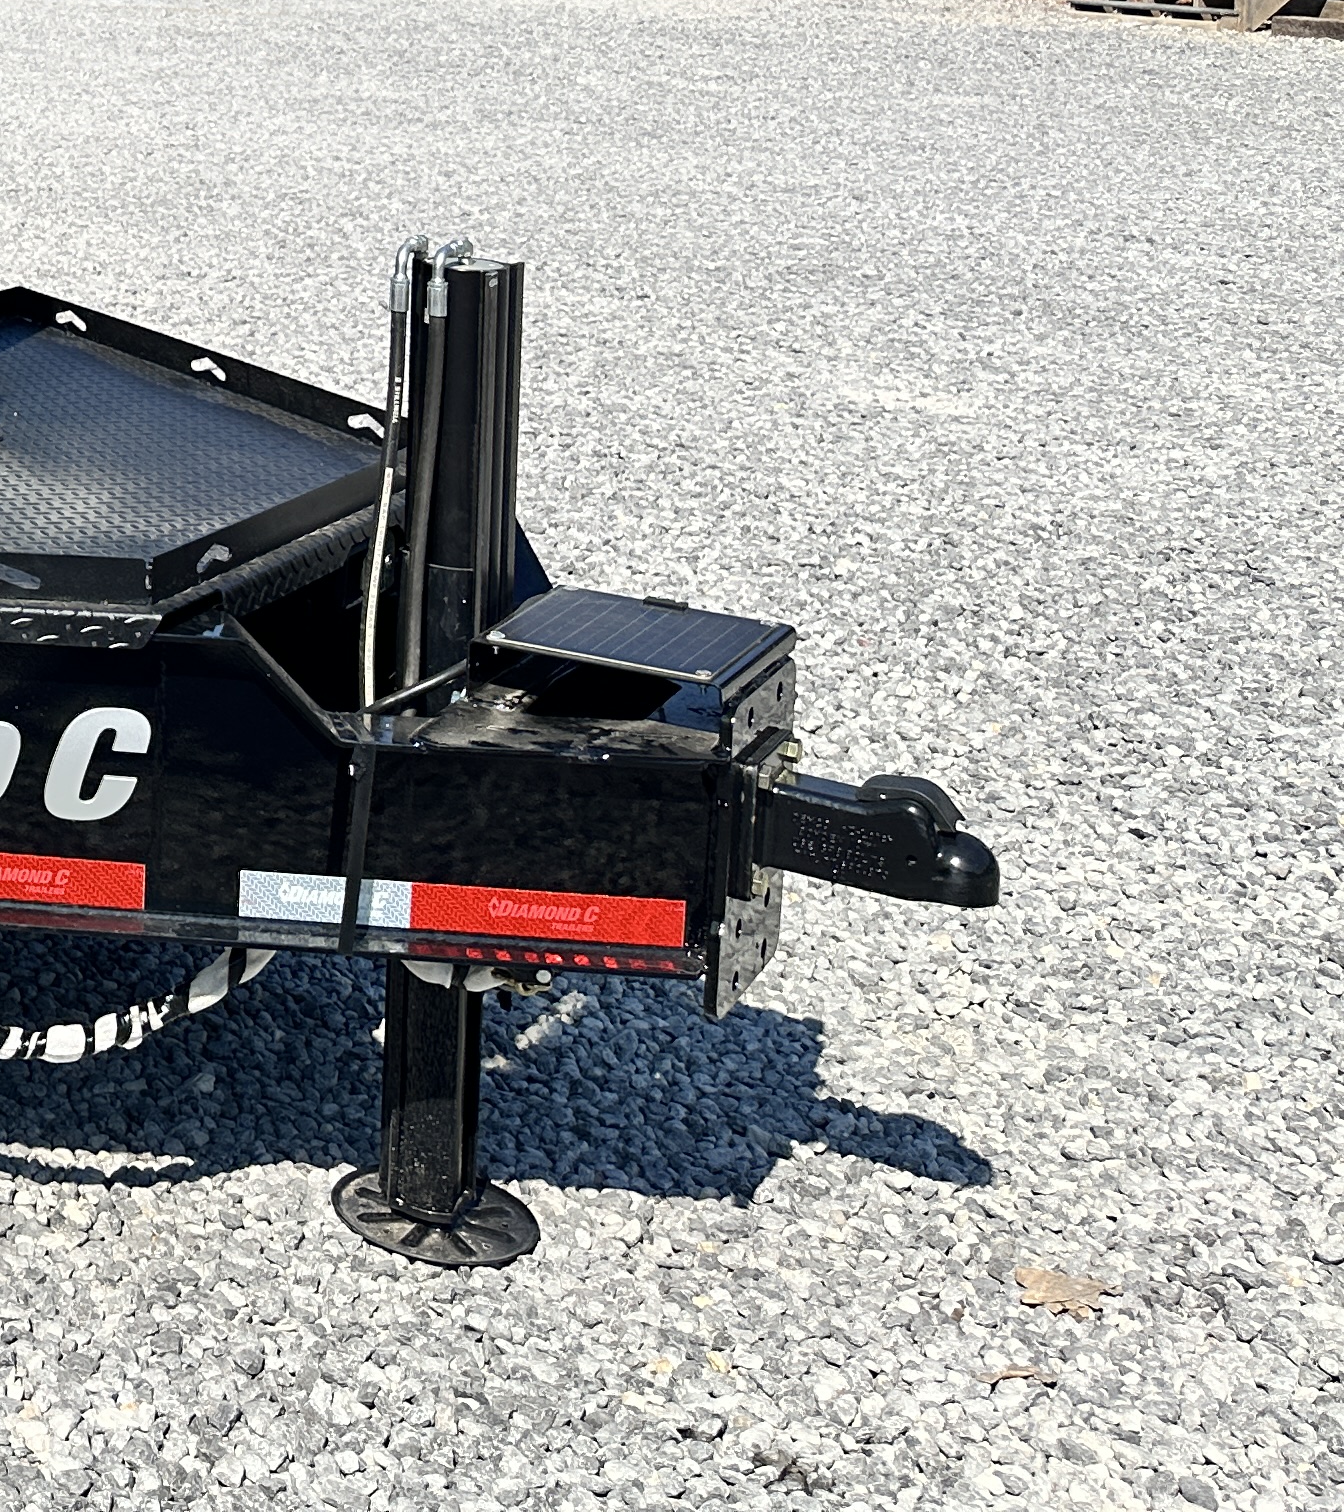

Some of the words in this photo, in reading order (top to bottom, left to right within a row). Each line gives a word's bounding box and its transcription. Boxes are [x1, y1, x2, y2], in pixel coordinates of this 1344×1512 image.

[43, 706, 152, 822] C
[54, 868, 70, 885] C
[496, 900, 582, 922] DIAMOND
[583, 905, 600, 923] C
